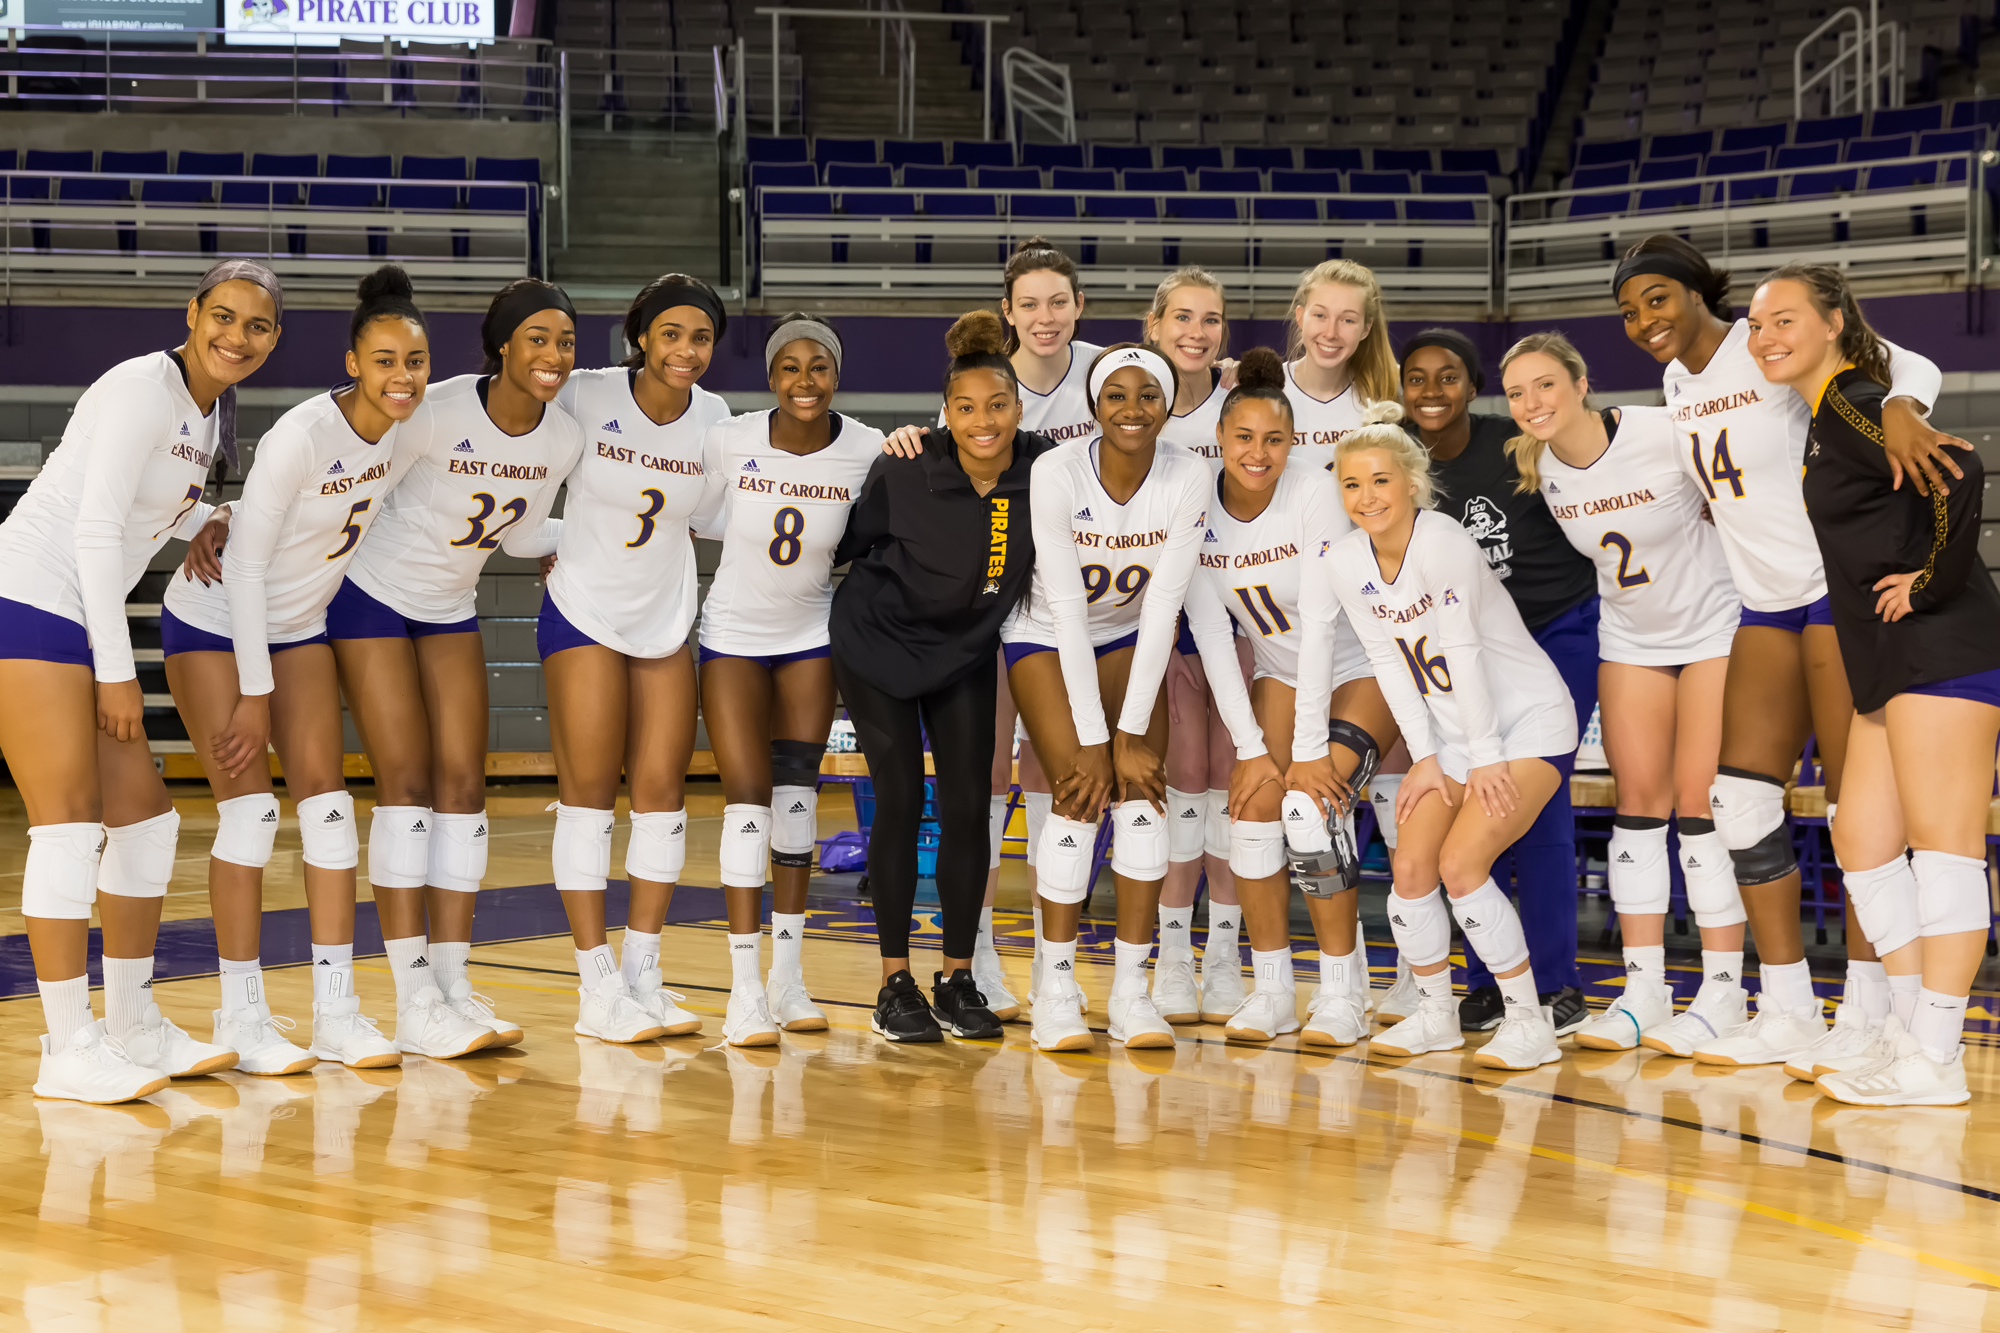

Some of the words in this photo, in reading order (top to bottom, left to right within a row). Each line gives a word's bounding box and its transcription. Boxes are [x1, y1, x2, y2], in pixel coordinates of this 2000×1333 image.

[298, 0, 398, 23] PIRATE
[407, 1, 480, 25] CLUB
[1694, 389, 1763, 417] CAROLINA
[601, 425, 622, 434] adidas
[171, 443, 194, 462] EAST
[448, 459, 488, 476] EAST
[491, 463, 549, 480] CAROLINA
[597, 441, 636, 464] EAST
[640, 454, 705, 476] CAROLINA
[1689, 427, 1746, 501] 14
[319, 477, 355, 495] EAST
[738, 475, 776, 494] EAST
[779, 482, 851, 502] CAROLINA
[1553, 504, 1579, 519] EAST
[1583, 488, 1656, 516] CAROLINA
[152, 483, 203, 540] 7
[449, 491, 528, 550] 32
[625, 487, 666, 549] 3
[1470, 502, 1486, 514] ECU
[325, 497, 373, 561] 5
[768, 505, 805, 567] 8
[987, 498, 1009, 578] PIRATES
[1199, 553, 1230, 569] EAST
[1234, 542, 1299, 569] CAROLINA
[1599, 530, 1651, 589] 2
[1080, 563, 1152, 608] 99
[1232, 584, 1293, 637] 11
[1394, 634, 1453, 696] 16
